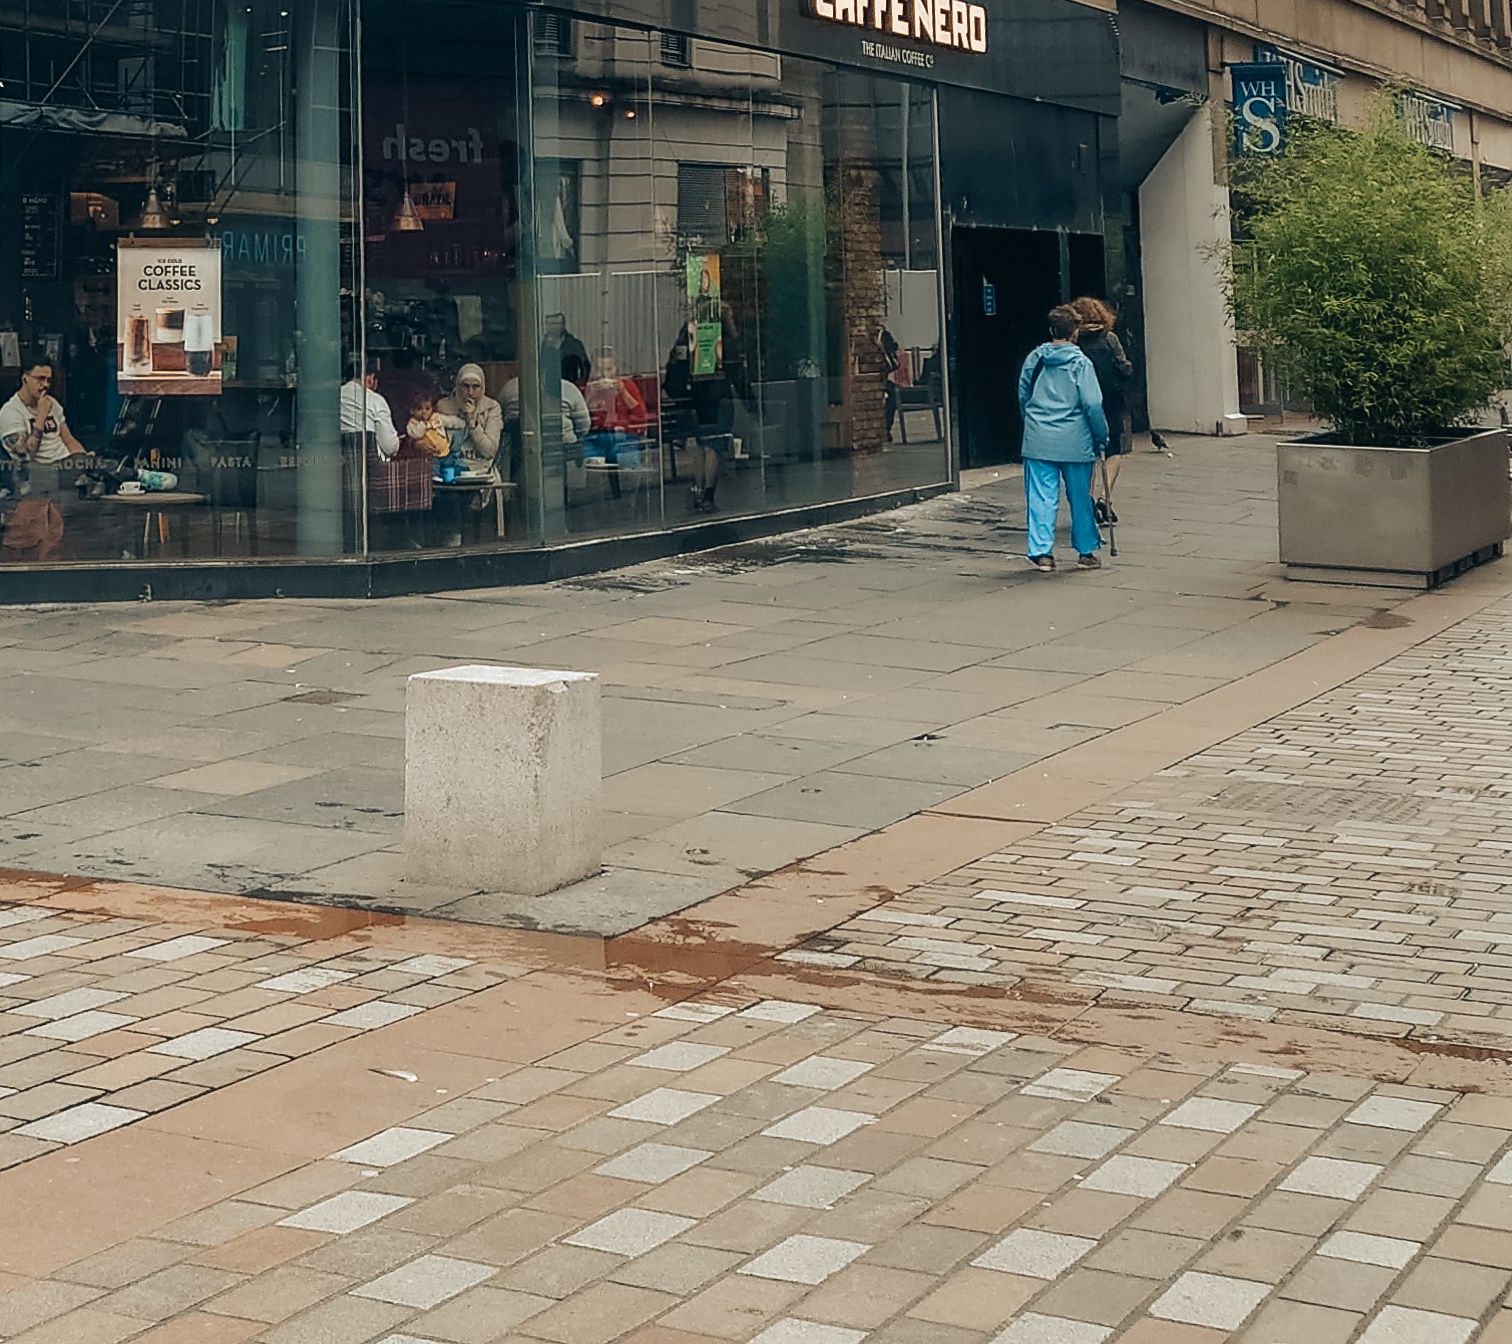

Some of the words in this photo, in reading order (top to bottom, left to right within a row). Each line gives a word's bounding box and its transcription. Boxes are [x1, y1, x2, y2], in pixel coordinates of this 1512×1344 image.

[862, 40, 875, 57] THE
[875, 43, 901, 63] ITALIAN
[902, 48, 925, 67] COFFEE
[1240, 80, 1277, 98] WH
[1242, 96, 1280, 152] S
[143, 265, 197, 277] COFFEE
[138, 278, 202, 291] CLASSICS
